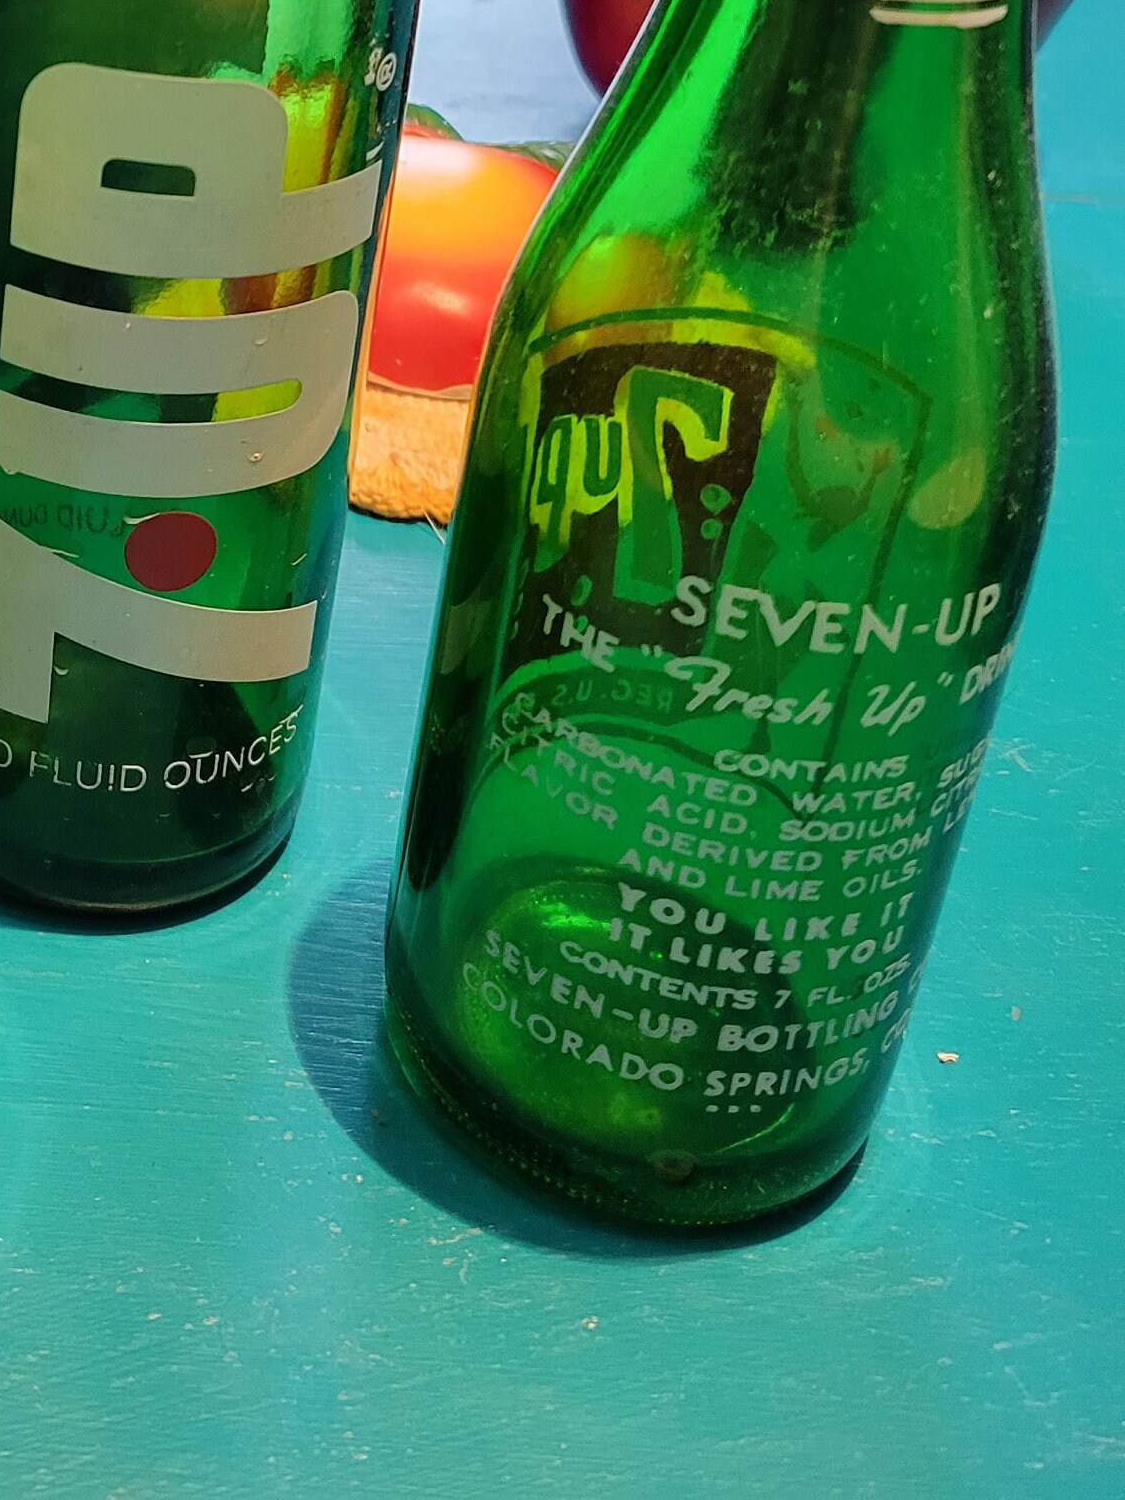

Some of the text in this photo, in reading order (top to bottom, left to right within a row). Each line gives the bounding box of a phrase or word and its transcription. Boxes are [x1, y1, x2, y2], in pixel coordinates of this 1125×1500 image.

[542, 593, 620, 672] THE
[671, 575, 1001, 654] SEVEN-UP
[28, 750, 147, 792] FLUID
[162, 717, 300, 789] OUNCES
[502, 711, 617, 796] CITRIC
[778, 808, 916, 842] SODIUM
[516, 692, 758, 806] CARBONATED
[713, 749, 911, 783] CONTAINS
[618, 848, 706, 889] AND
[725, 876, 823, 901] LIME
[642, 822, 823, 872] DERIVED
[841, 826, 932, 871] FROM
[609, 917, 905, 975] IT LIKES YOU
[617, 881, 915, 941] YOU LIKE IT
[486, 929, 699, 1044] SEVEN-UP
[716, 990, 899, 1053] BOTTLING
[559, 940, 760, 1011] CONTENTS
[774, 989, 792, 1009] 7
[463, 962, 685, 1092] COLORADO
